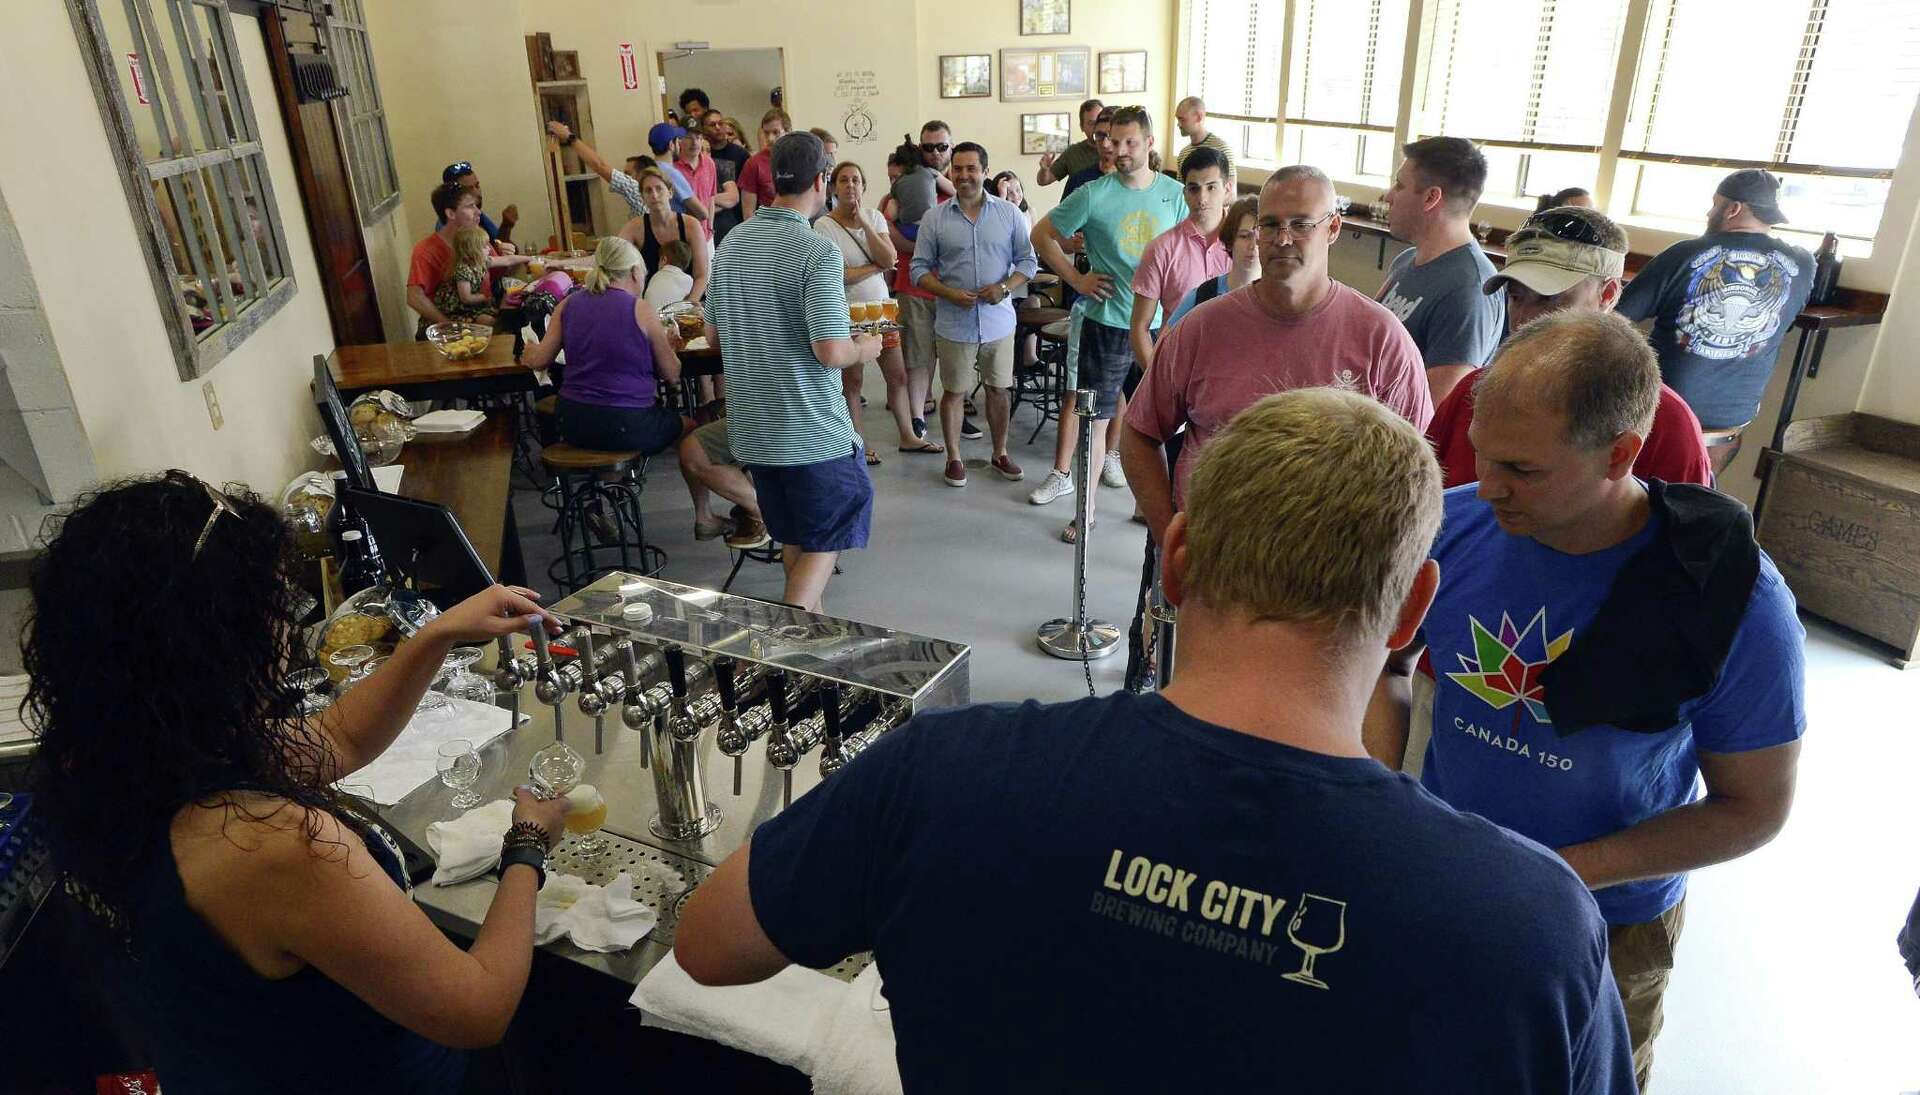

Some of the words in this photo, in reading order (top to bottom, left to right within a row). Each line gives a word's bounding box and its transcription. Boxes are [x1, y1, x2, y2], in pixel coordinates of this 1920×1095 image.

[1808, 510, 1879, 552] GAMES
[1454, 716, 1531, 758] CANADA
[1538, 751, 1573, 771] 150
[1103, 849, 1198, 913] LOCK
[1200, 880, 1287, 937] CITY
[1090, 890, 1177, 938] BREWING
[1181, 919, 1279, 966] COMPANY
